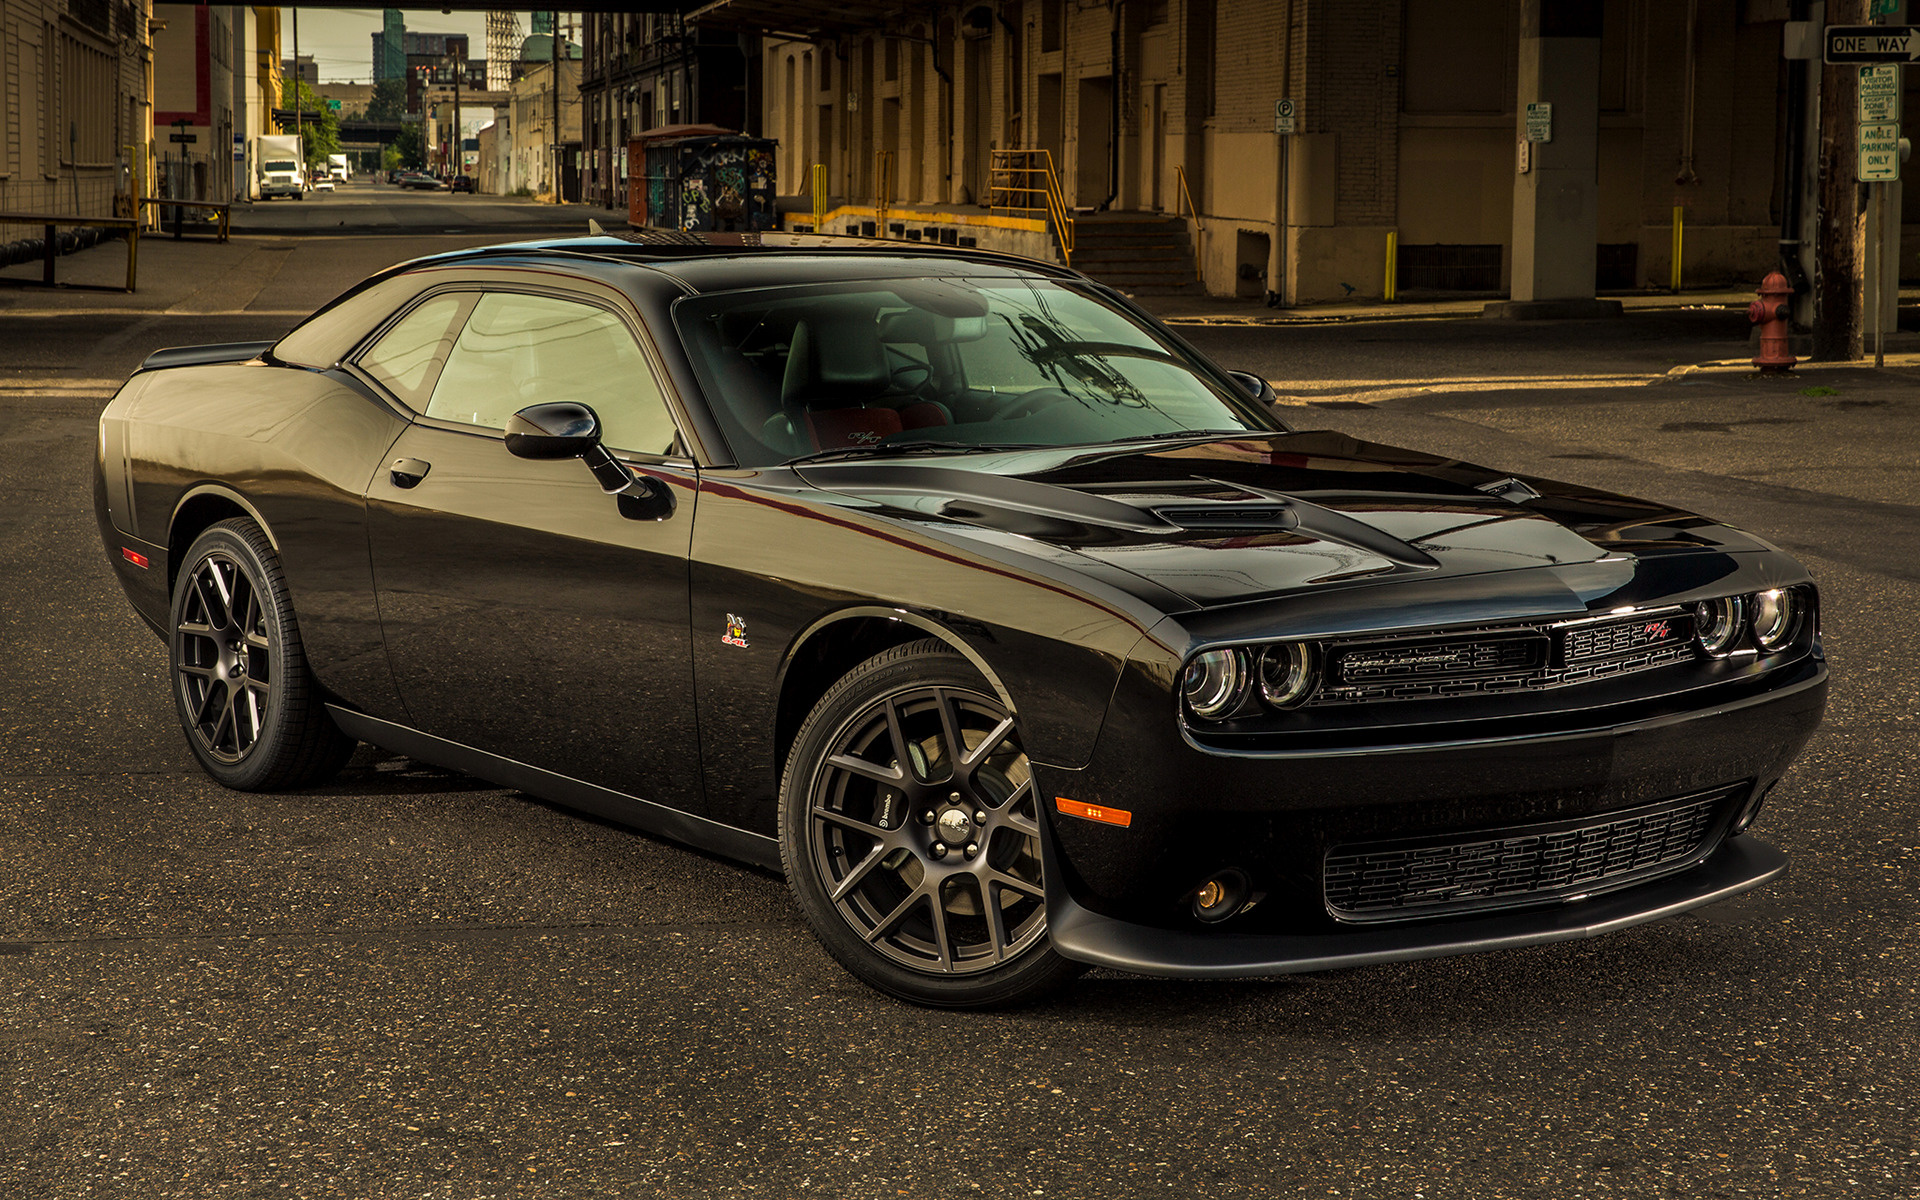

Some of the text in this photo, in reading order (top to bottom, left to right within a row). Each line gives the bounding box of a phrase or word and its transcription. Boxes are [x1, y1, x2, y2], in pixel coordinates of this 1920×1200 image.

[1834, 38, 1909, 51] ONE WAY
[1282, 104, 1289, 113] P
[1865, 130, 1892, 139] ANGLE
[1862, 142, 1896, 151] PARKING
[1868, 156, 1889, 165] ONLY
[1643, 619, 1672, 642] R/T
[1344, 654, 1458, 669] CHALLENGER
[881, 793, 892, 820] brembo
